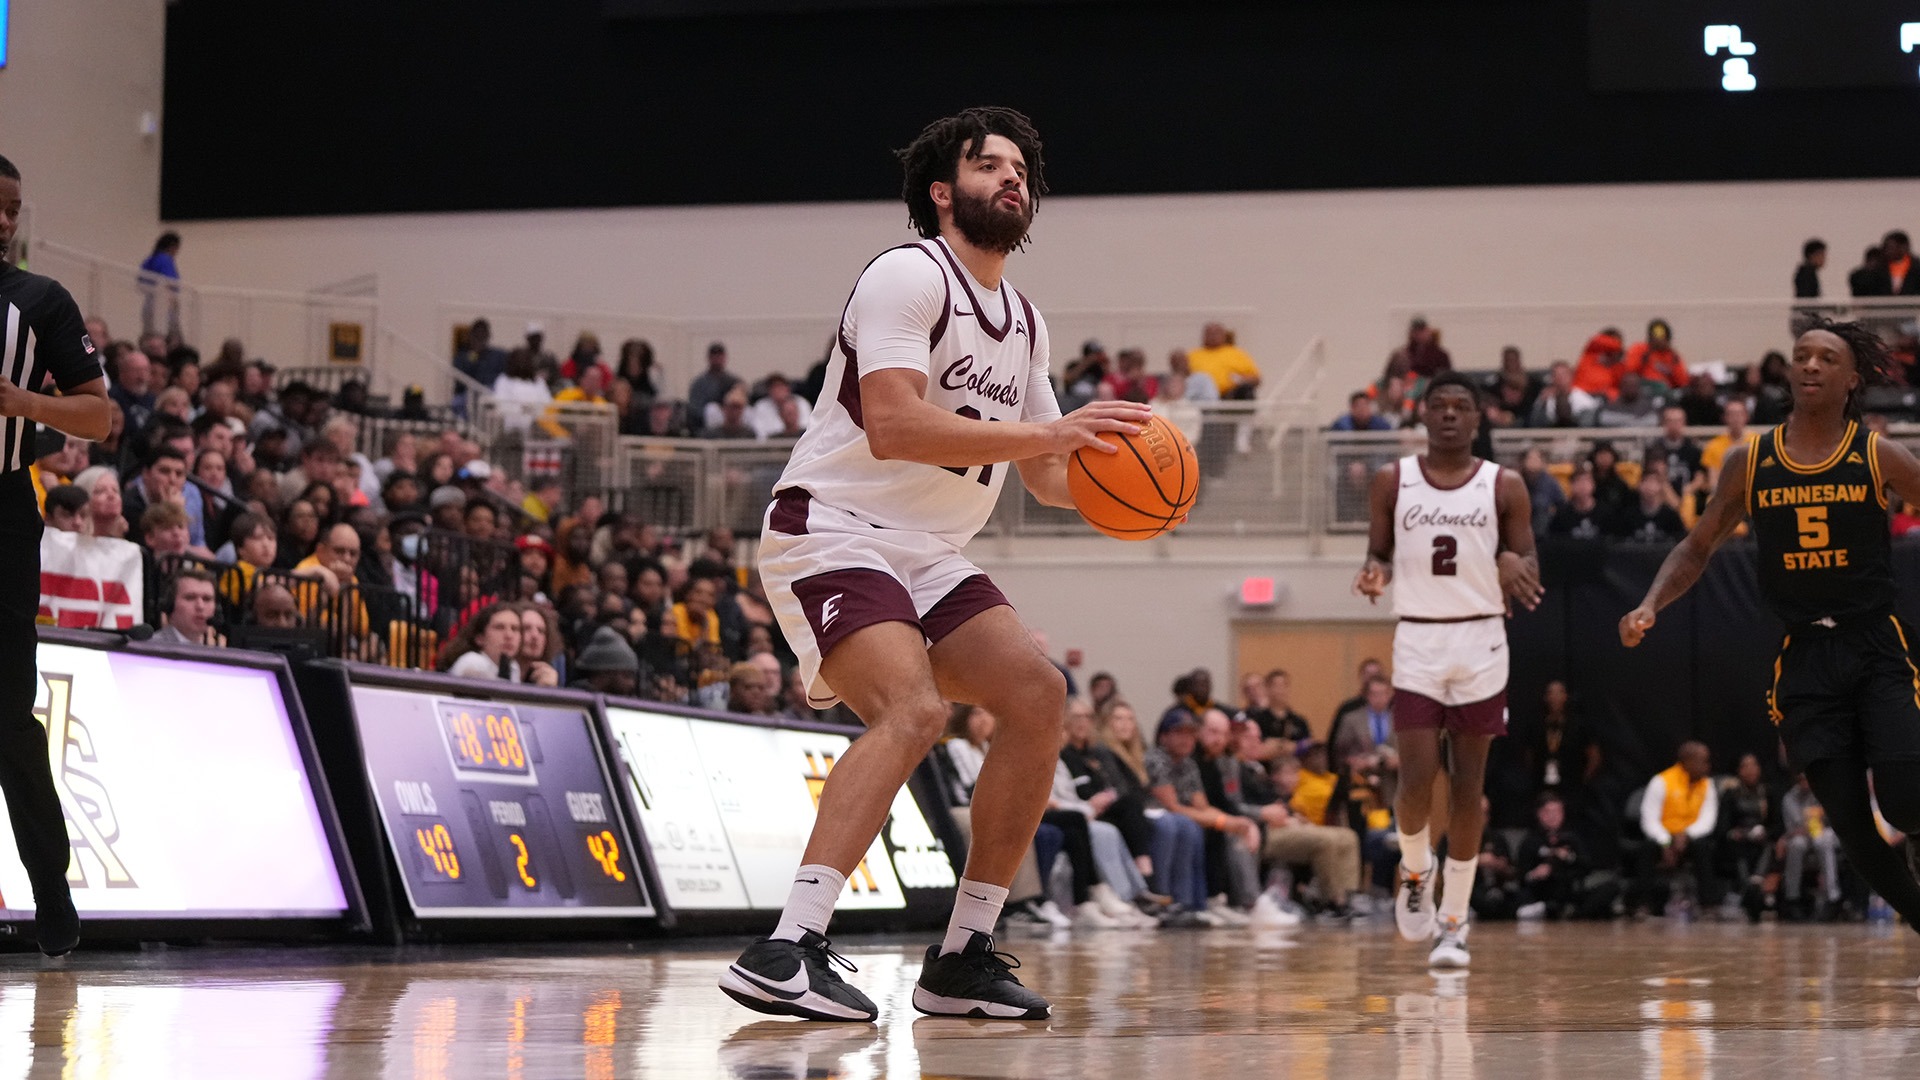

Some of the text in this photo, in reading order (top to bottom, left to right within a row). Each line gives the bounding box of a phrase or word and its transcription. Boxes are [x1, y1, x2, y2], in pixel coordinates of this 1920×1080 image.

[1757, 484, 1868, 508] KENNESAW
[1403, 504, 1488, 531] Colonels
[1794, 505, 1830, 549] 5
[1431, 535, 1458, 576] 2
[1783, 549, 1849, 570] STATE
[452, 712, 525, 768] 18:08
[394, 780, 438, 815] OWLS
[565, 791, 607, 823] GUEST
[416, 824, 460, 879] 40
[510, 833, 536, 888] 2
[586, 830, 626, 882] 42
